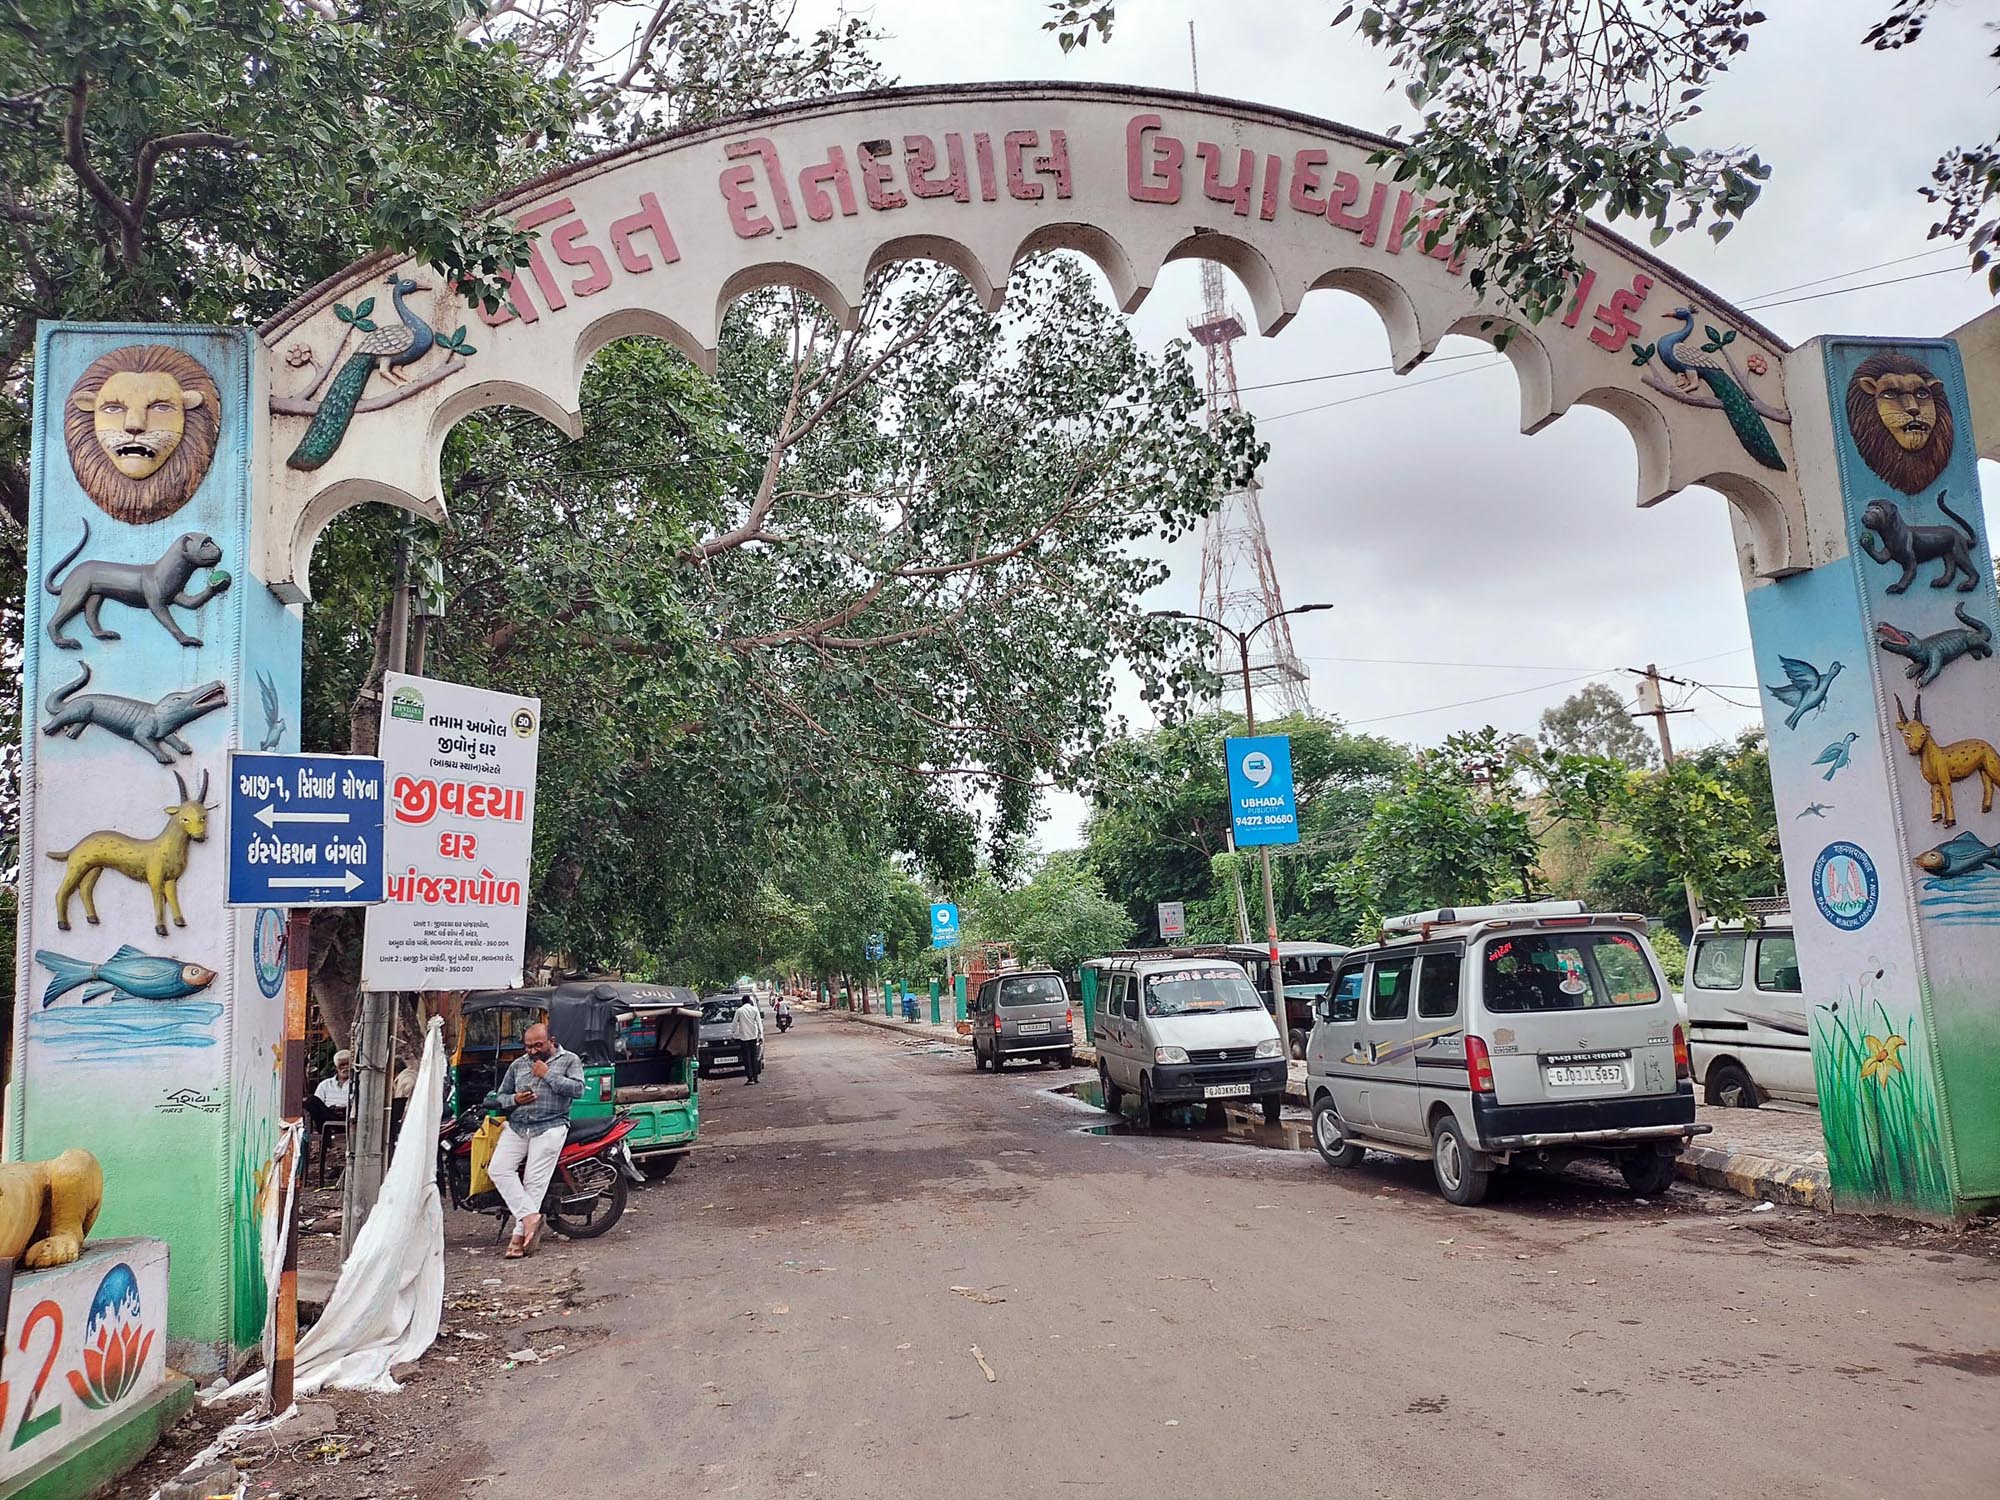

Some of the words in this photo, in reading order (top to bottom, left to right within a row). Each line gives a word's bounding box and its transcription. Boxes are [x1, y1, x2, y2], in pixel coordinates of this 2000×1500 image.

[429, 715, 463, 731] તમામ
[466, 719, 508, 737] અબોલ
[518, 716, 530, 727] 50
[438, 736, 477, 760] જીવોનું
[479, 743, 497, 757] ઘર
[342, 769, 378, 801] યોજના
[393, 776, 524, 824] જીવદયા
[1241, 796, 1285, 808] UBHADA
[1235, 815, 1263, 827] 94272
[1264, 813, 1294, 825] 80680
[324, 835, 367, 865] બંગલો
[439, 833, 477, 860] ઘર
[387, 867, 521, 906] પાંજરાપોળ
